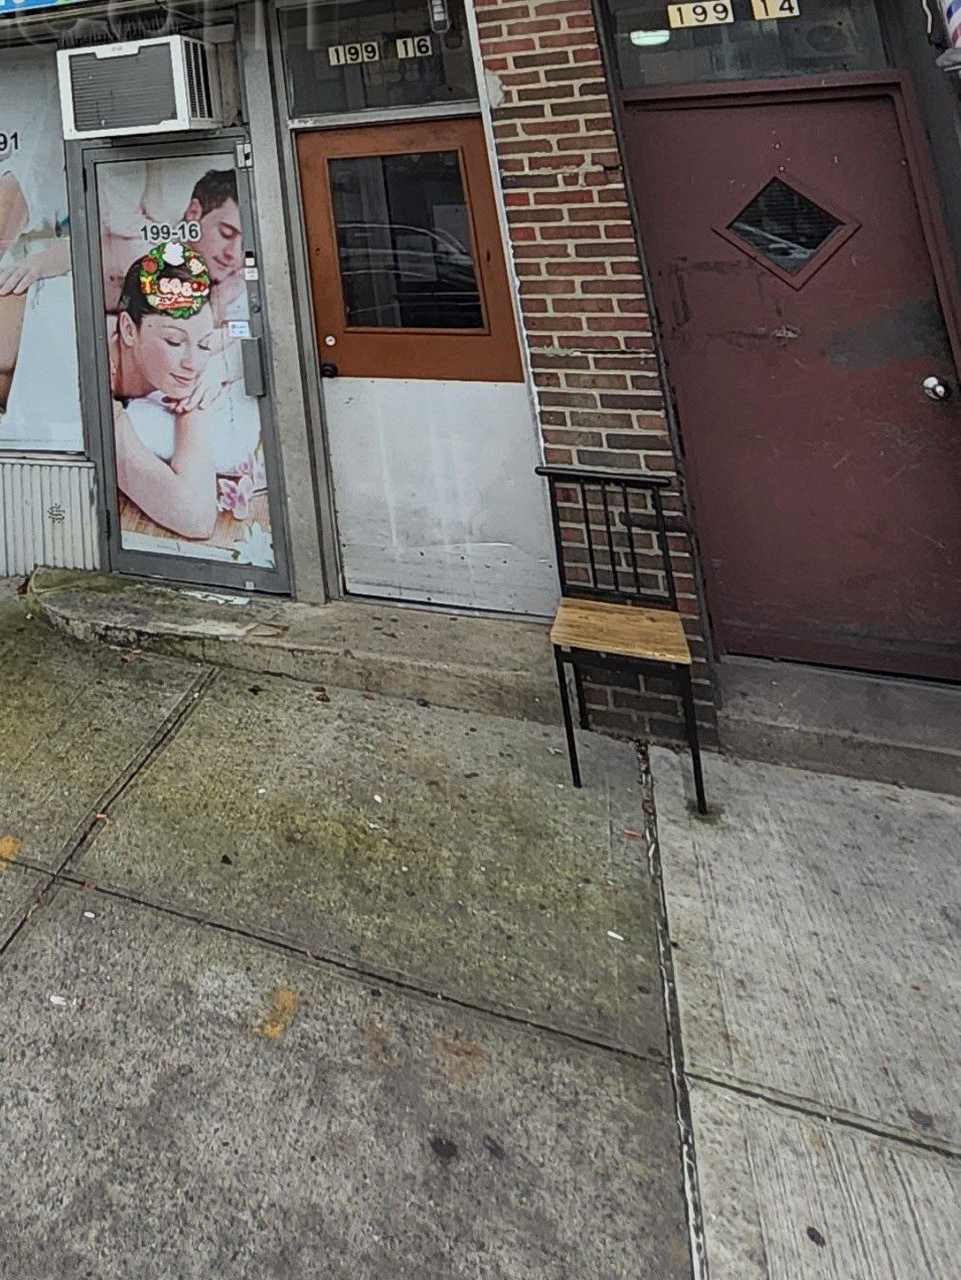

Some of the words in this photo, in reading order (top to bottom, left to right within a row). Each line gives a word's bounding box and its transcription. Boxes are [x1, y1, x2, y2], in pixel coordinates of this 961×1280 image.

[676, 2, 730, 25] 199
[334, 43, 377, 64] 199
[401, 37, 430, 57] 16
[140, 222, 199, 241] 199-16
